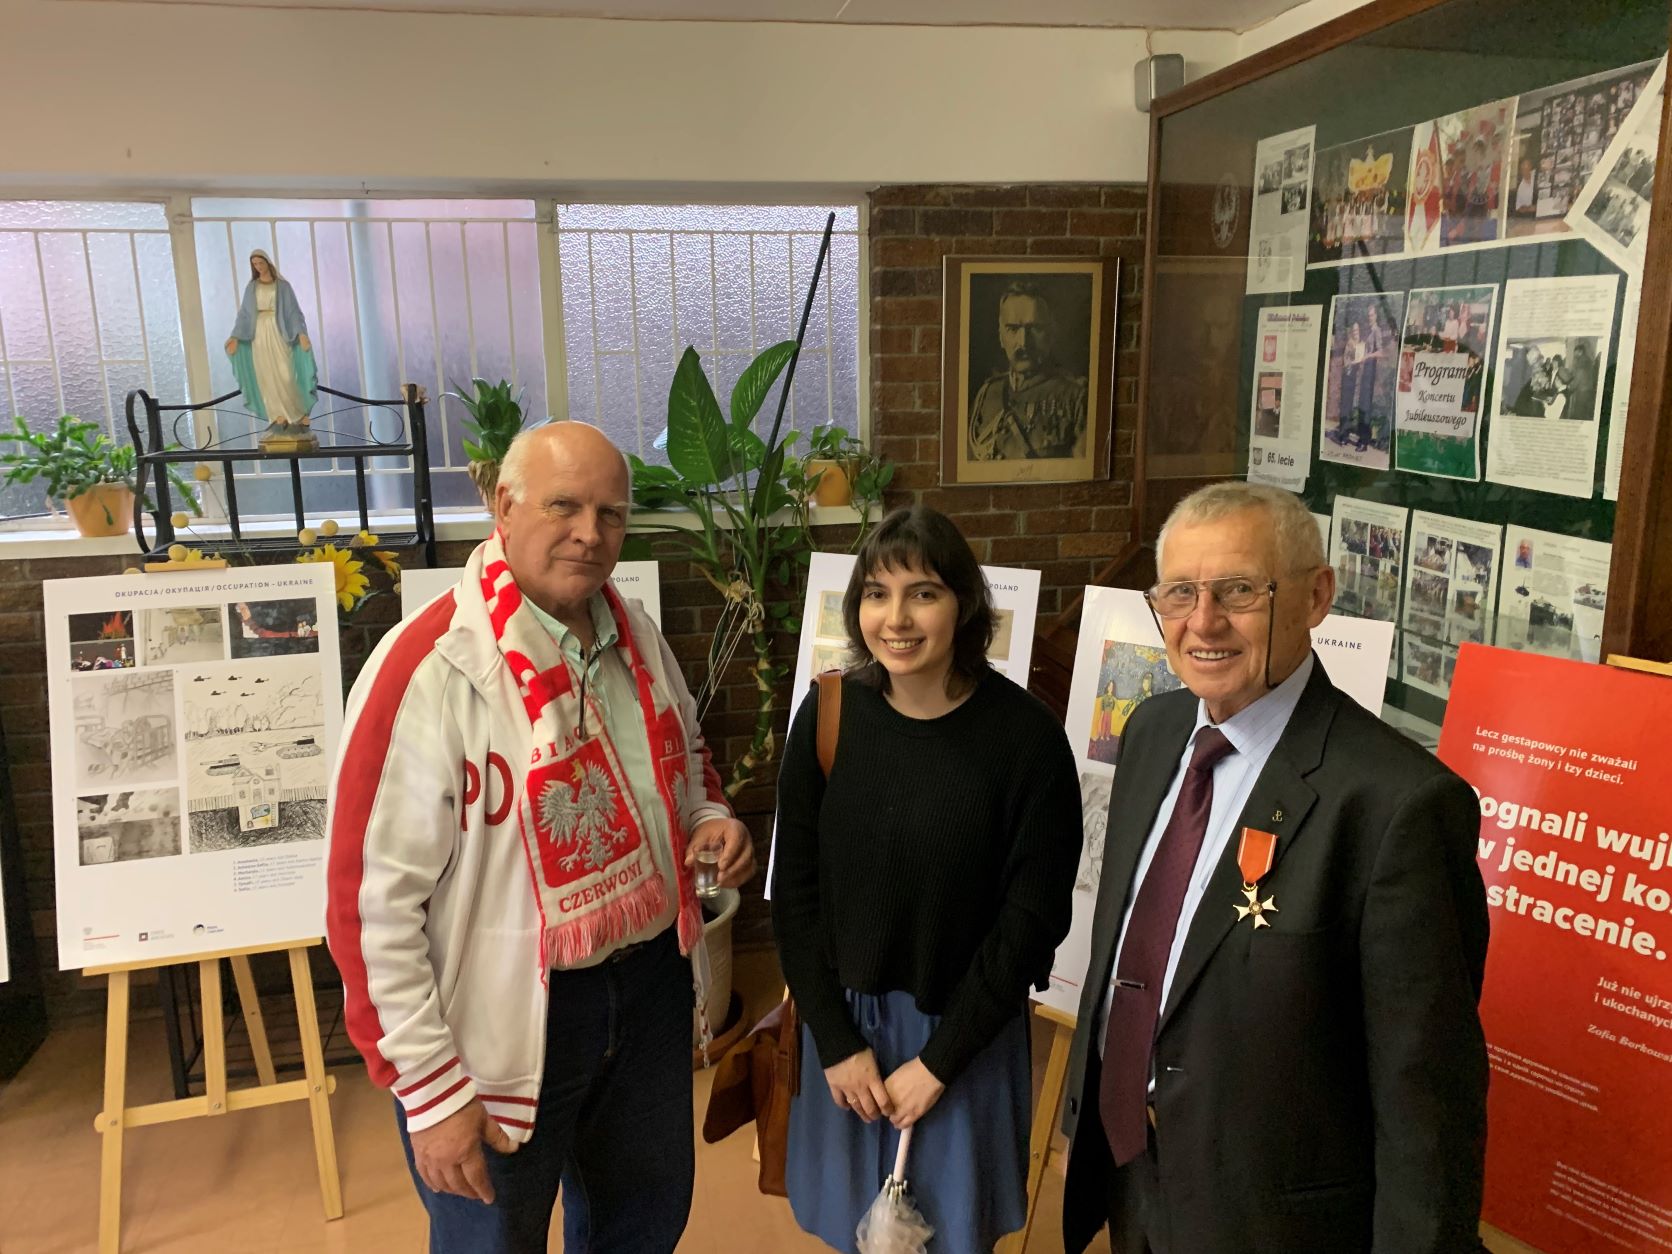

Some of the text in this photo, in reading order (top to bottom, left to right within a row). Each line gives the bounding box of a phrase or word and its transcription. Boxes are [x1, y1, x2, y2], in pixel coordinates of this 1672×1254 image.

[1418, 390, 1456, 403] Koncertu
[1404, 409, 1467, 430] Jubileuszowego
[1317, 637, 1362, 650] UKRAINE
[1472, 743, 1485, 752] na
[1488, 745, 1525, 763] prośbę
[1527, 754, 1555, 770] żony
[1564, 762, 1583, 776] łzy
[1585, 767, 1625, 785] dzieci.
[1475, 726, 1638, 771] Lecz gestapowcy nie zważali
[1471, 785, 1672, 871] ognali wuj
[559, 859, 643, 913] CZERWONI
[1498, 837, 1616, 902] jednej
[1622, 872, 1672, 916] ko
[1487, 884, 1667, 961] stracenie.
[1594, 992, 1599, 1003] i
[1597, 976, 1672, 1014] Już nie ujrz
[1587, 1024, 1617, 1042] Zofia
